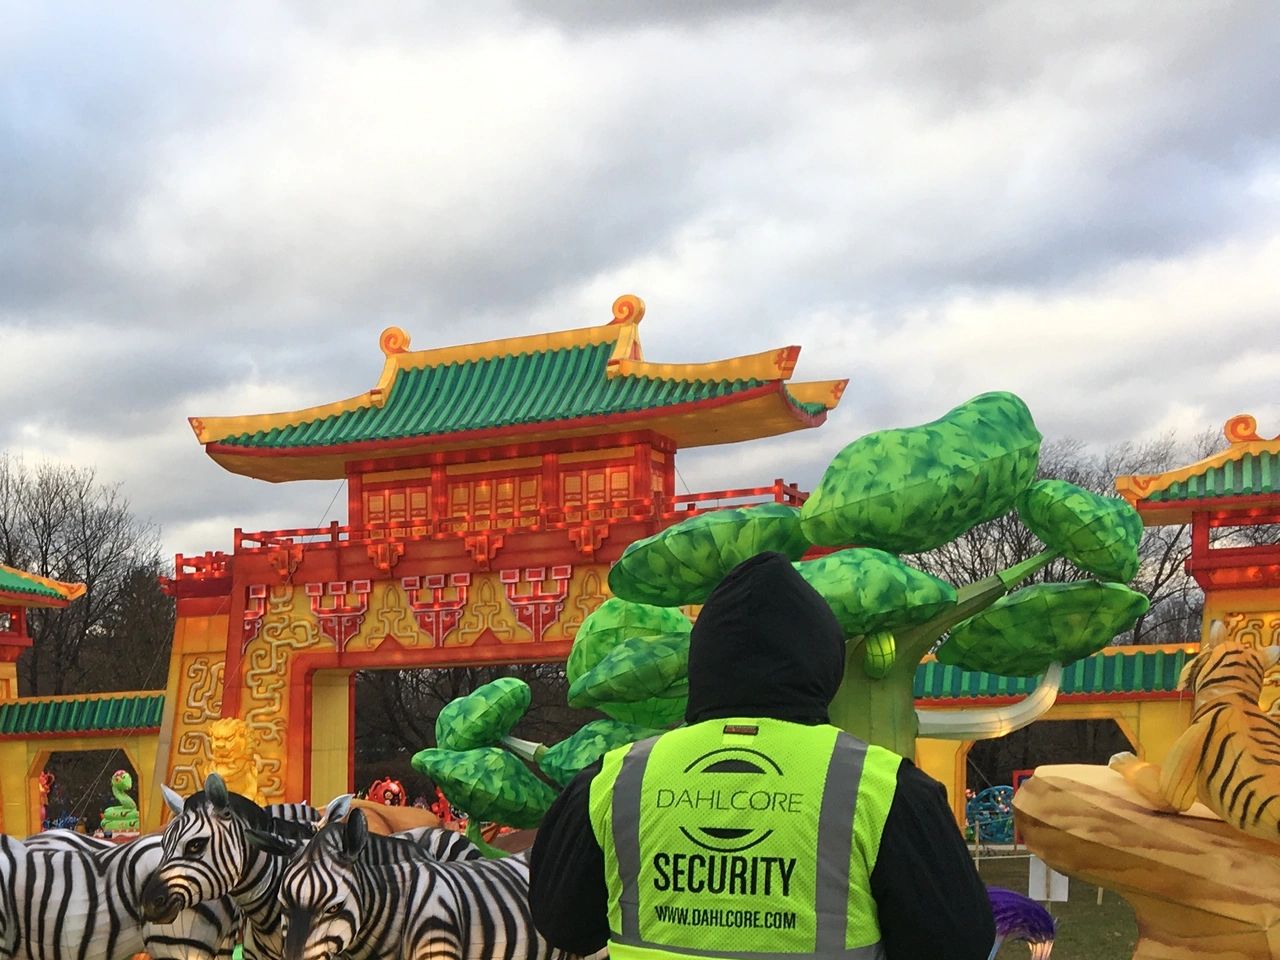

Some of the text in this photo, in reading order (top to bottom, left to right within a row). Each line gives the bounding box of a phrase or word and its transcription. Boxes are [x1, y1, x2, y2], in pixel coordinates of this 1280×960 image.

[656, 788, 804, 813] DAHLCORE
[653, 853, 797, 897] SECURITY
[655, 905, 797, 930] WWW.DAHLCORE.COM
